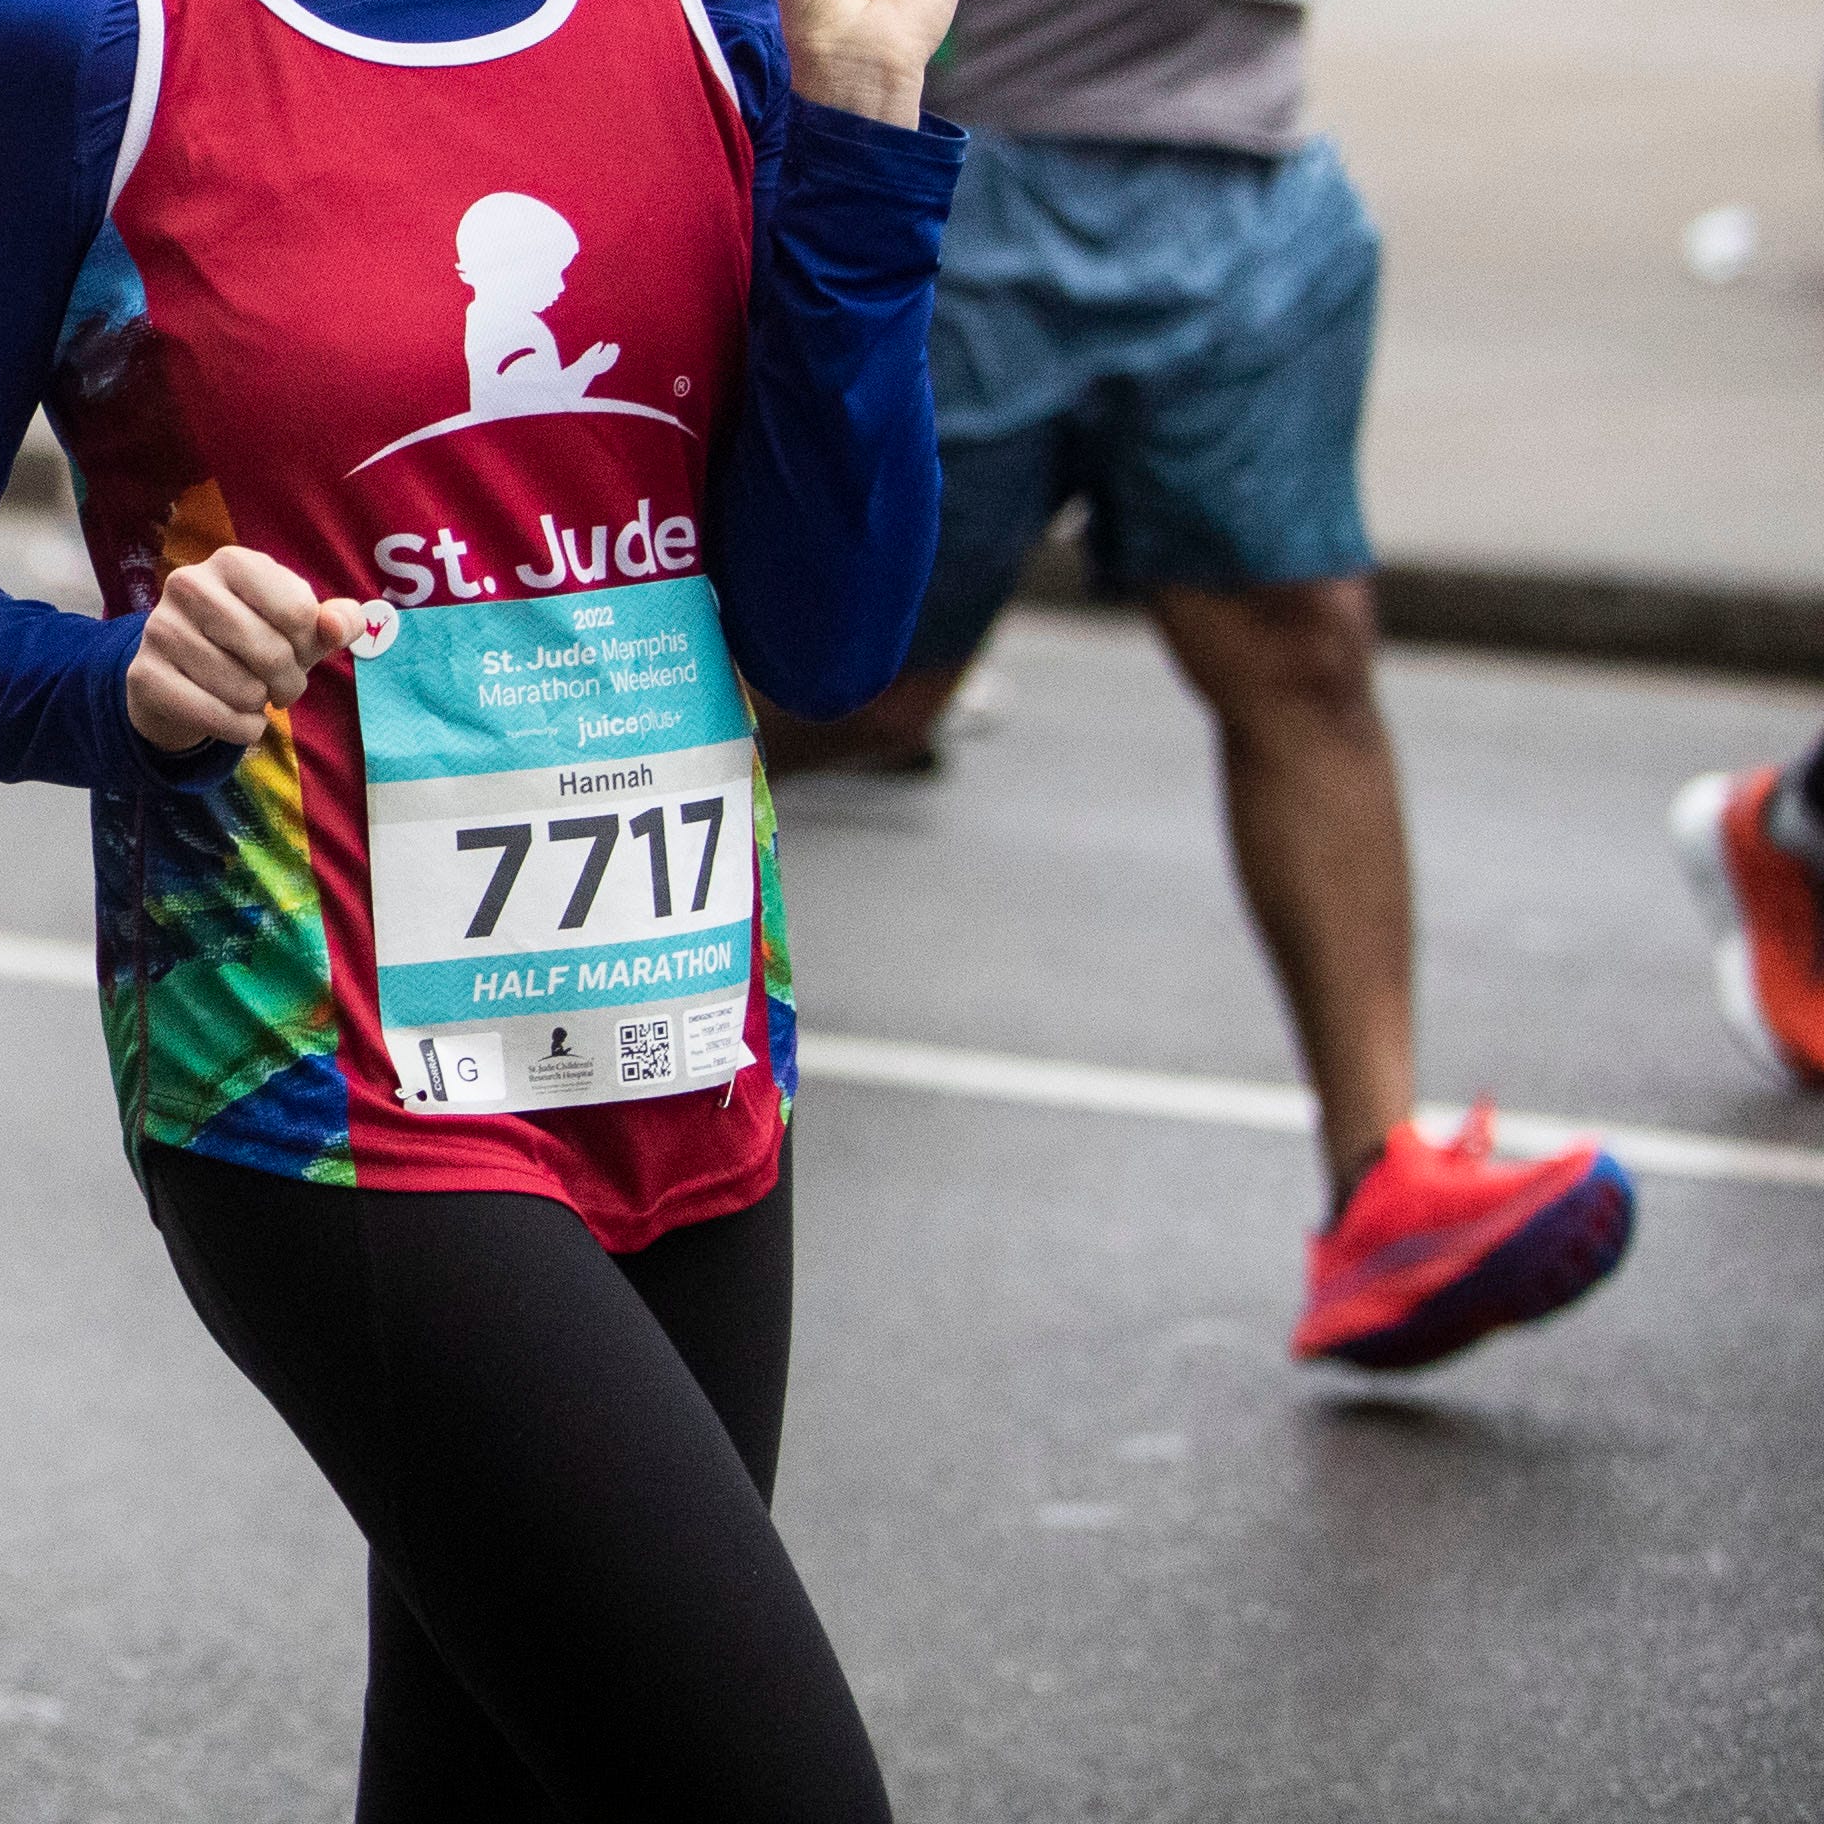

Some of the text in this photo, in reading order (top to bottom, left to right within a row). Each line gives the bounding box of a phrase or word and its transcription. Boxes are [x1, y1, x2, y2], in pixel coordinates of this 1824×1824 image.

[374, 498, 697, 608] St. Jude
[573, 605, 615, 631] 2022
[482, 627, 689, 675] St. Jude Memphis
[478, 658, 698, 708] Marathon Weekend
[559, 763, 654, 797] Hannah
[455, 796, 724, 939] 7717
[472, 941, 732, 1003] HALF MARATHON
[425, 1048, 444, 1093] CORRAL
[457, 1057, 479, 1082] G
